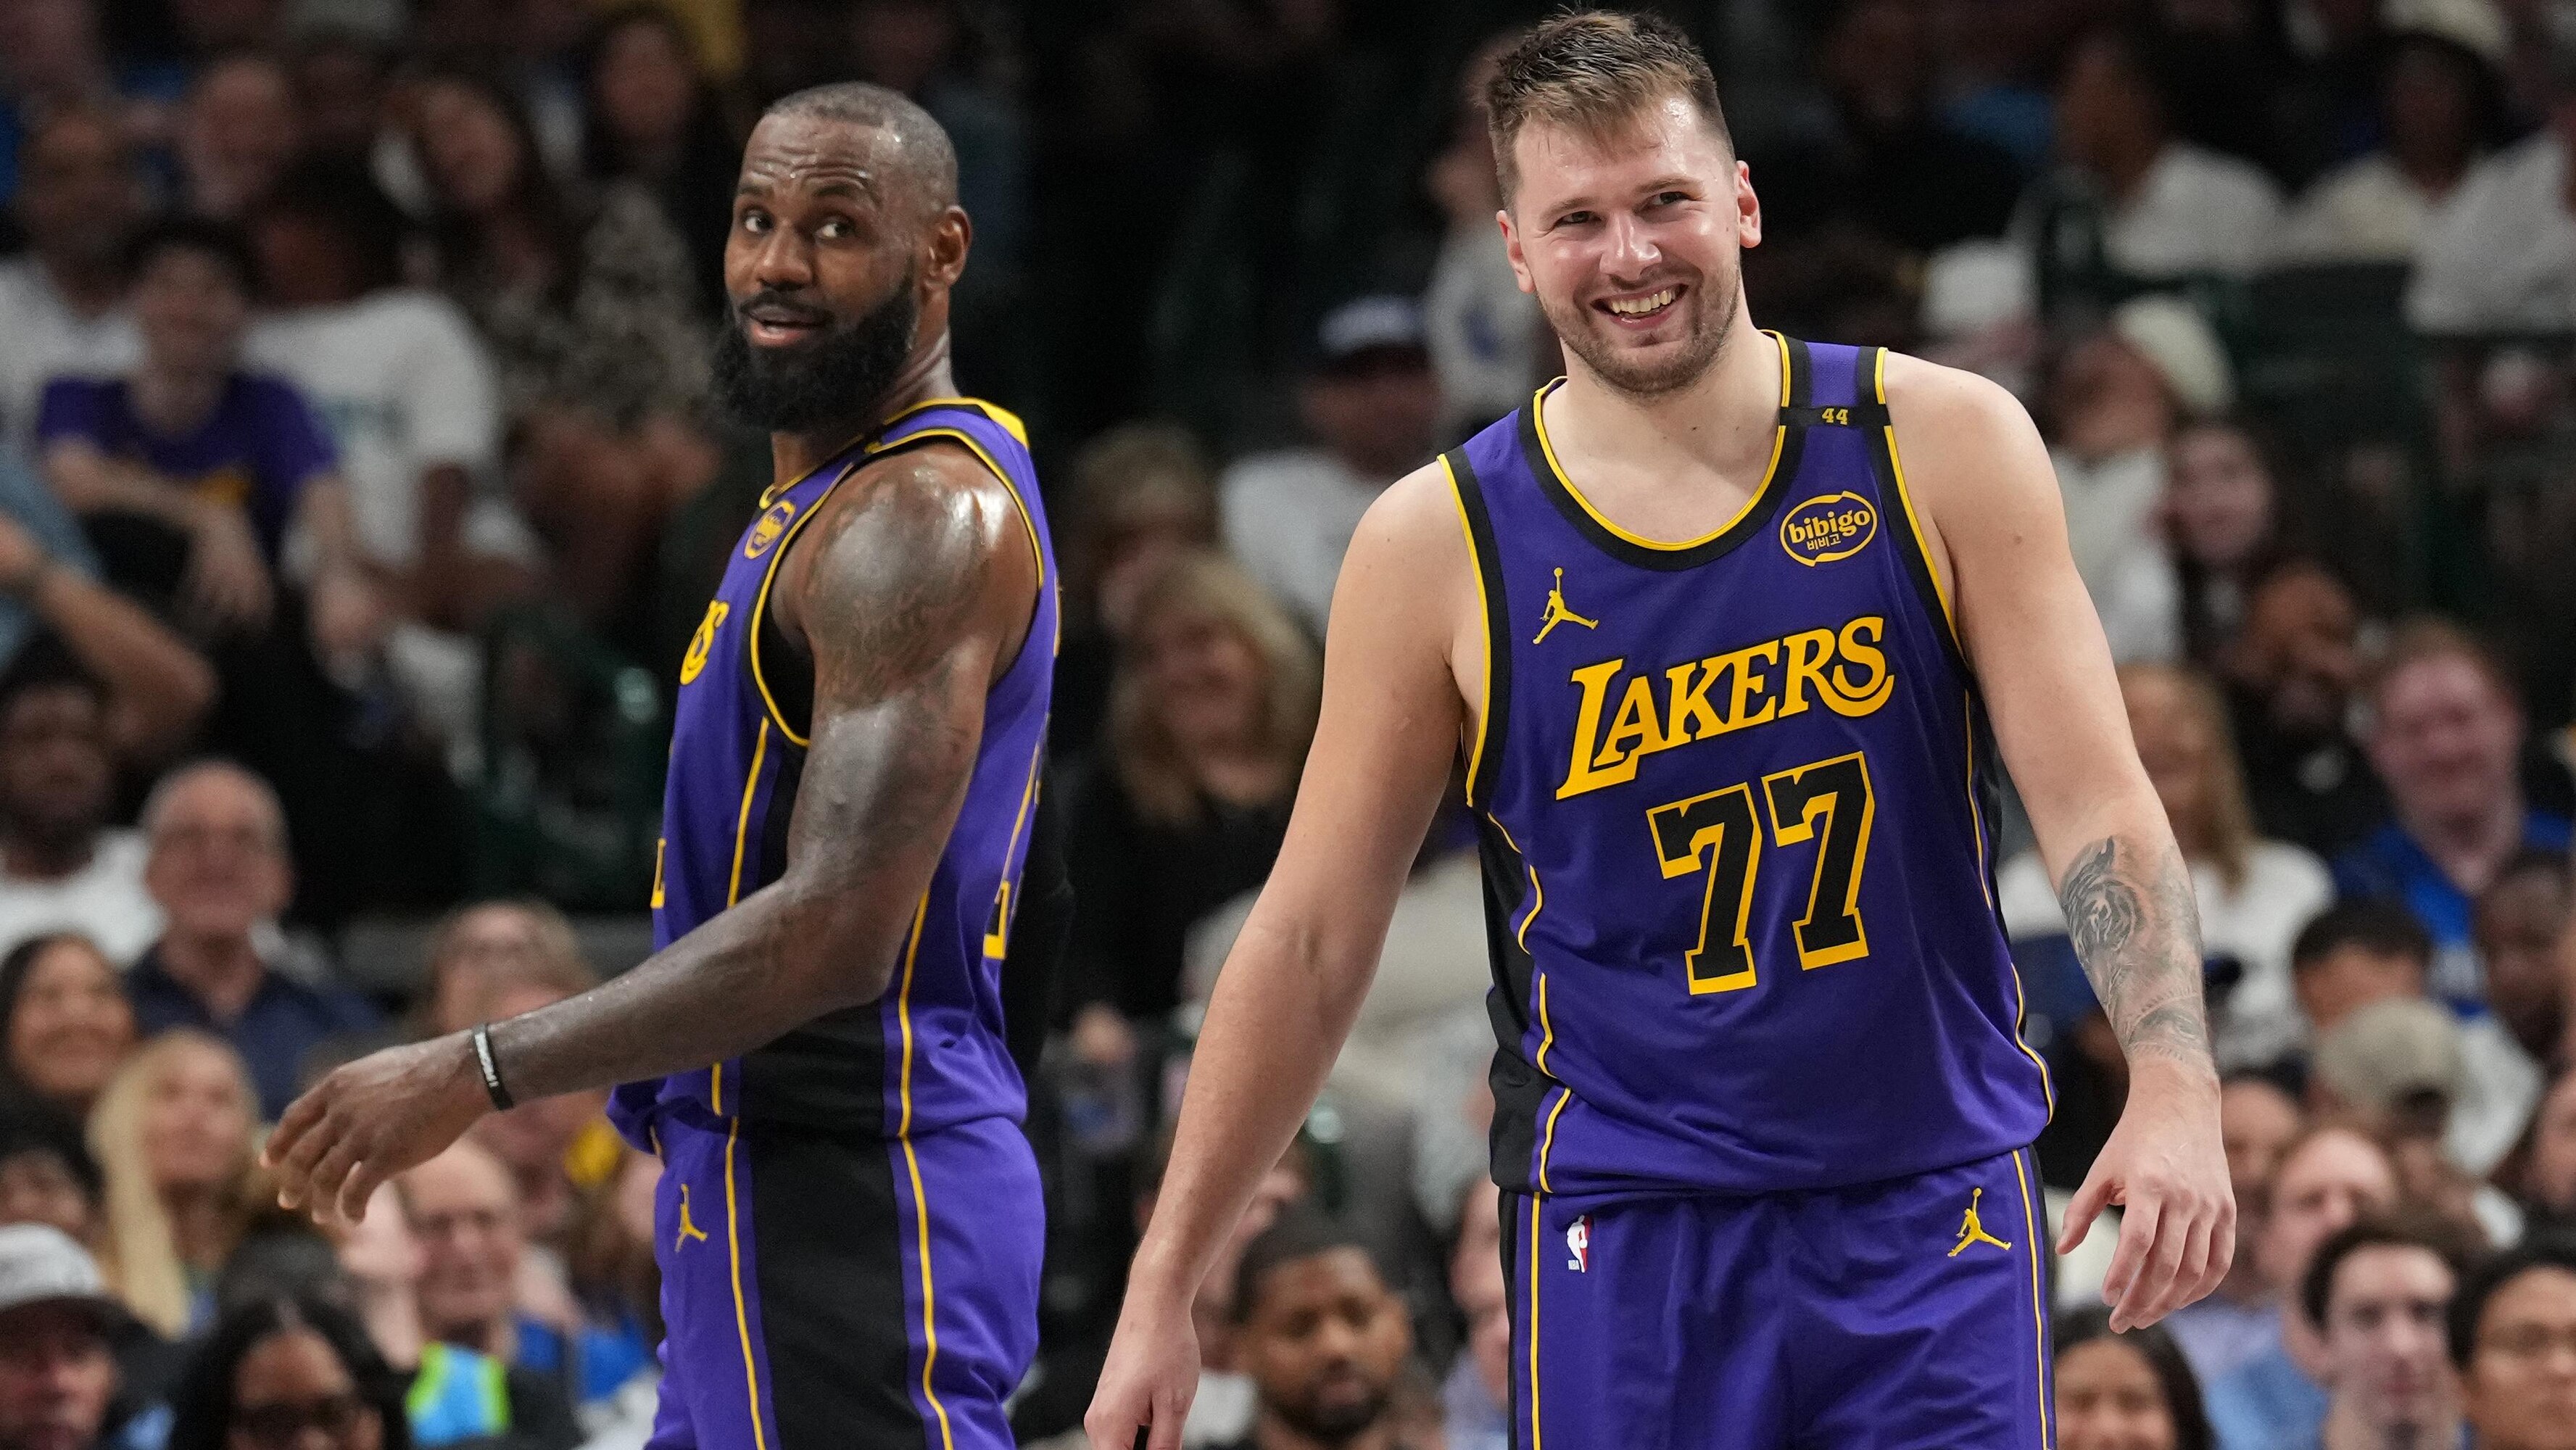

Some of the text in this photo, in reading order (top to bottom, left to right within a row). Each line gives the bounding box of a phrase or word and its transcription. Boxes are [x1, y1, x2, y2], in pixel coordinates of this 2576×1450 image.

[1821, 408, 1848, 425] 44
[1788, 510, 1871, 543] bibigo
[1806, 534, 1842, 550] 비비고
[1555, 617, 1894, 801] LAKERS
[1645, 750, 1876, 995] 77
